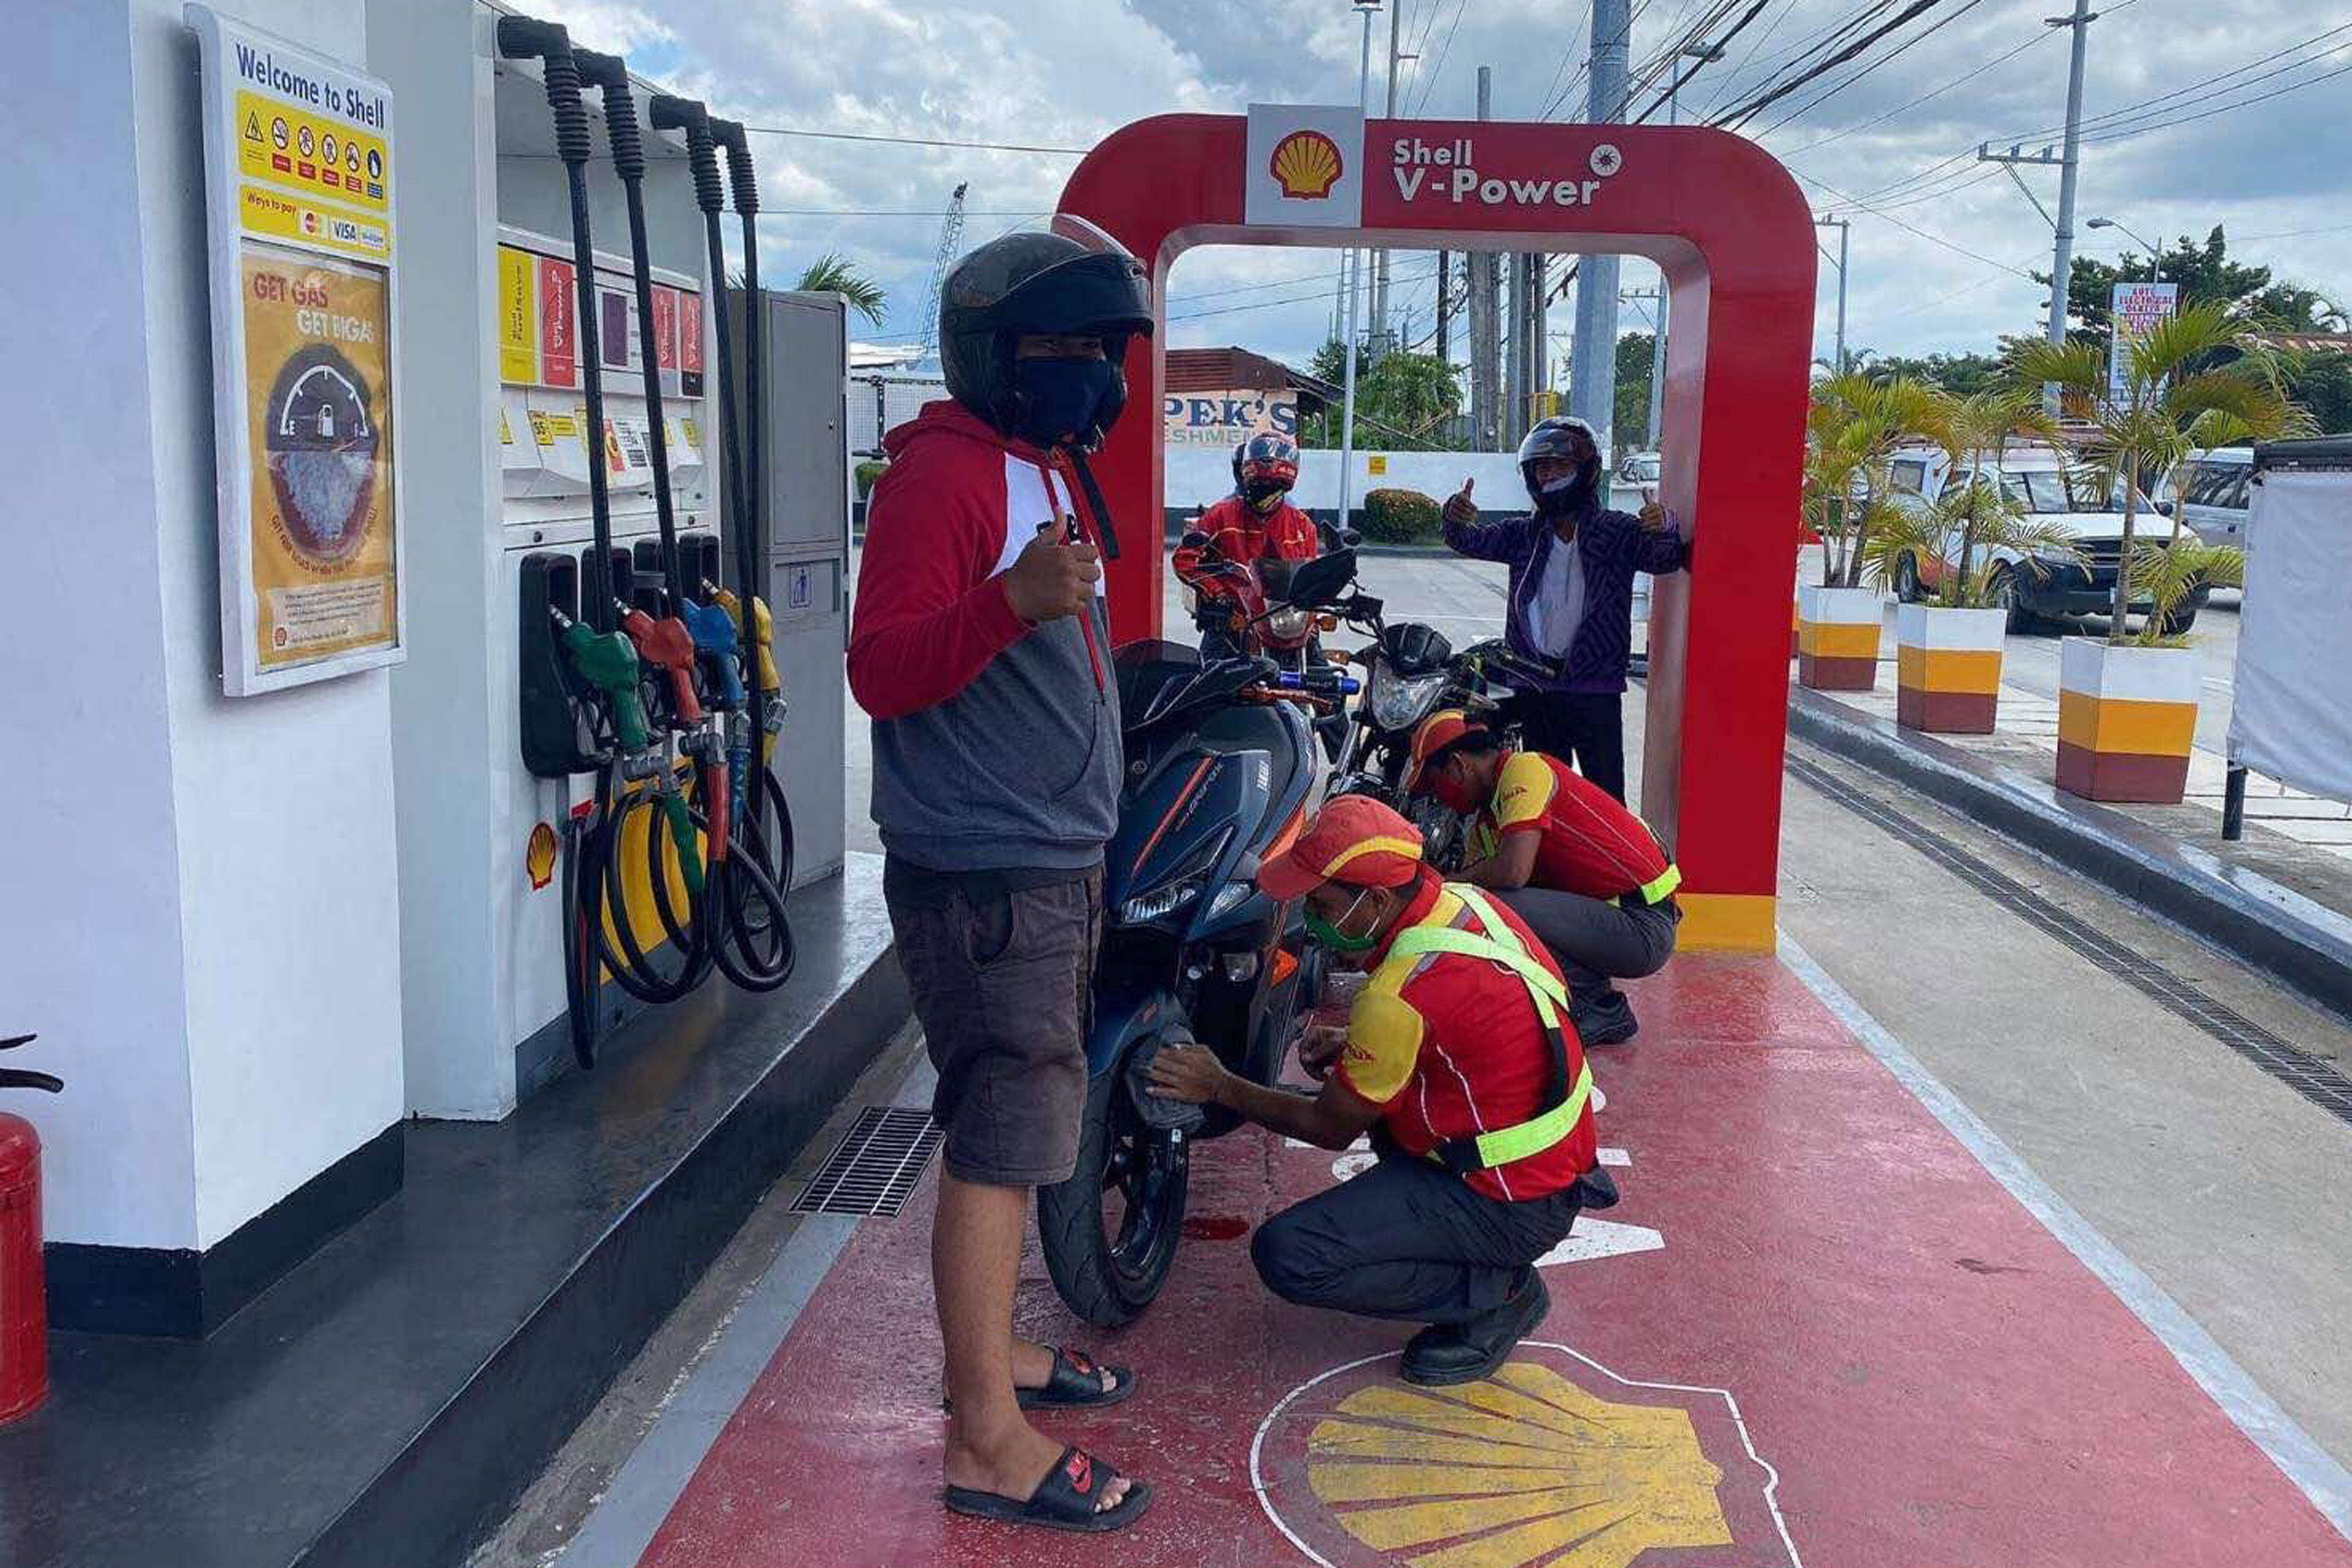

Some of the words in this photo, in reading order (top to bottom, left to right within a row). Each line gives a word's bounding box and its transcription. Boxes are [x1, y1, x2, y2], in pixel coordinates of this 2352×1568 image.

[235, 43, 320, 104] Welcome
[323, 83, 341, 112] to
[345, 89, 384, 130] Shell
[1394, 138, 1473, 166] Shell
[1393, 167, 1600, 206] V-Power
[247, 191, 270, 209] Ways
[271, 199, 280, 209] to
[281, 202, 298, 216] pay
[333, 220, 357, 242] VISA
[254, 273, 287, 302] GET
[291, 279, 328, 308] GAS
[297, 309, 329, 338] GET
